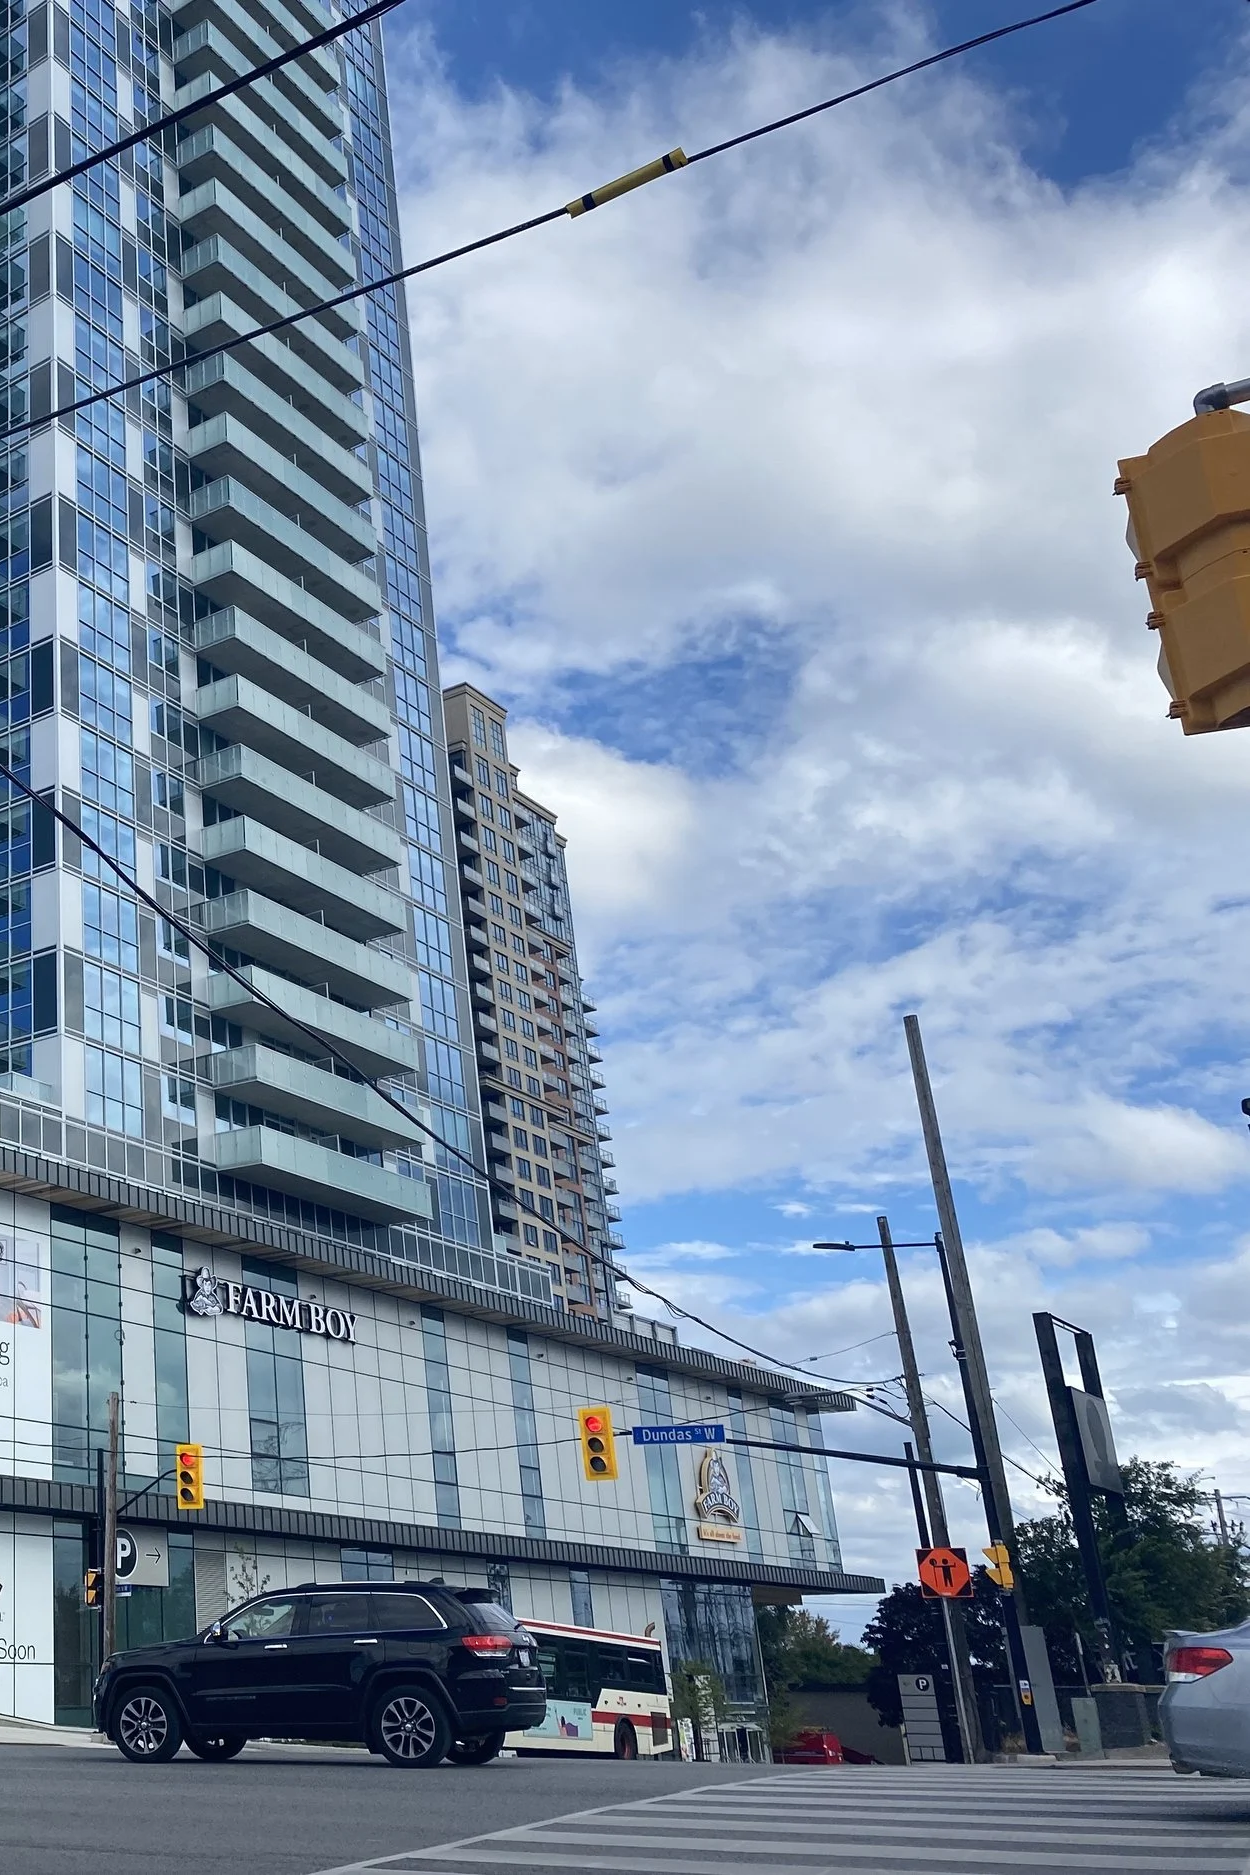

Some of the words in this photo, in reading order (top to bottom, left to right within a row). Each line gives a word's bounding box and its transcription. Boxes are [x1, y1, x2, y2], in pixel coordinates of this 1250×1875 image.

[226, 1282, 303, 1329] FARM
[308, 1304, 359, 1342] BOY
[642, 1428, 692, 1441] Dundas
[694, 1427, 702, 1435] St
[704, 1427, 715, 1440] W
[703, 1493, 723, 1513] FARM
[720, 1493, 739, 1513] BOY
[116, 1538, 131, 1569] P
[919, 1679, 927, 1690] P
